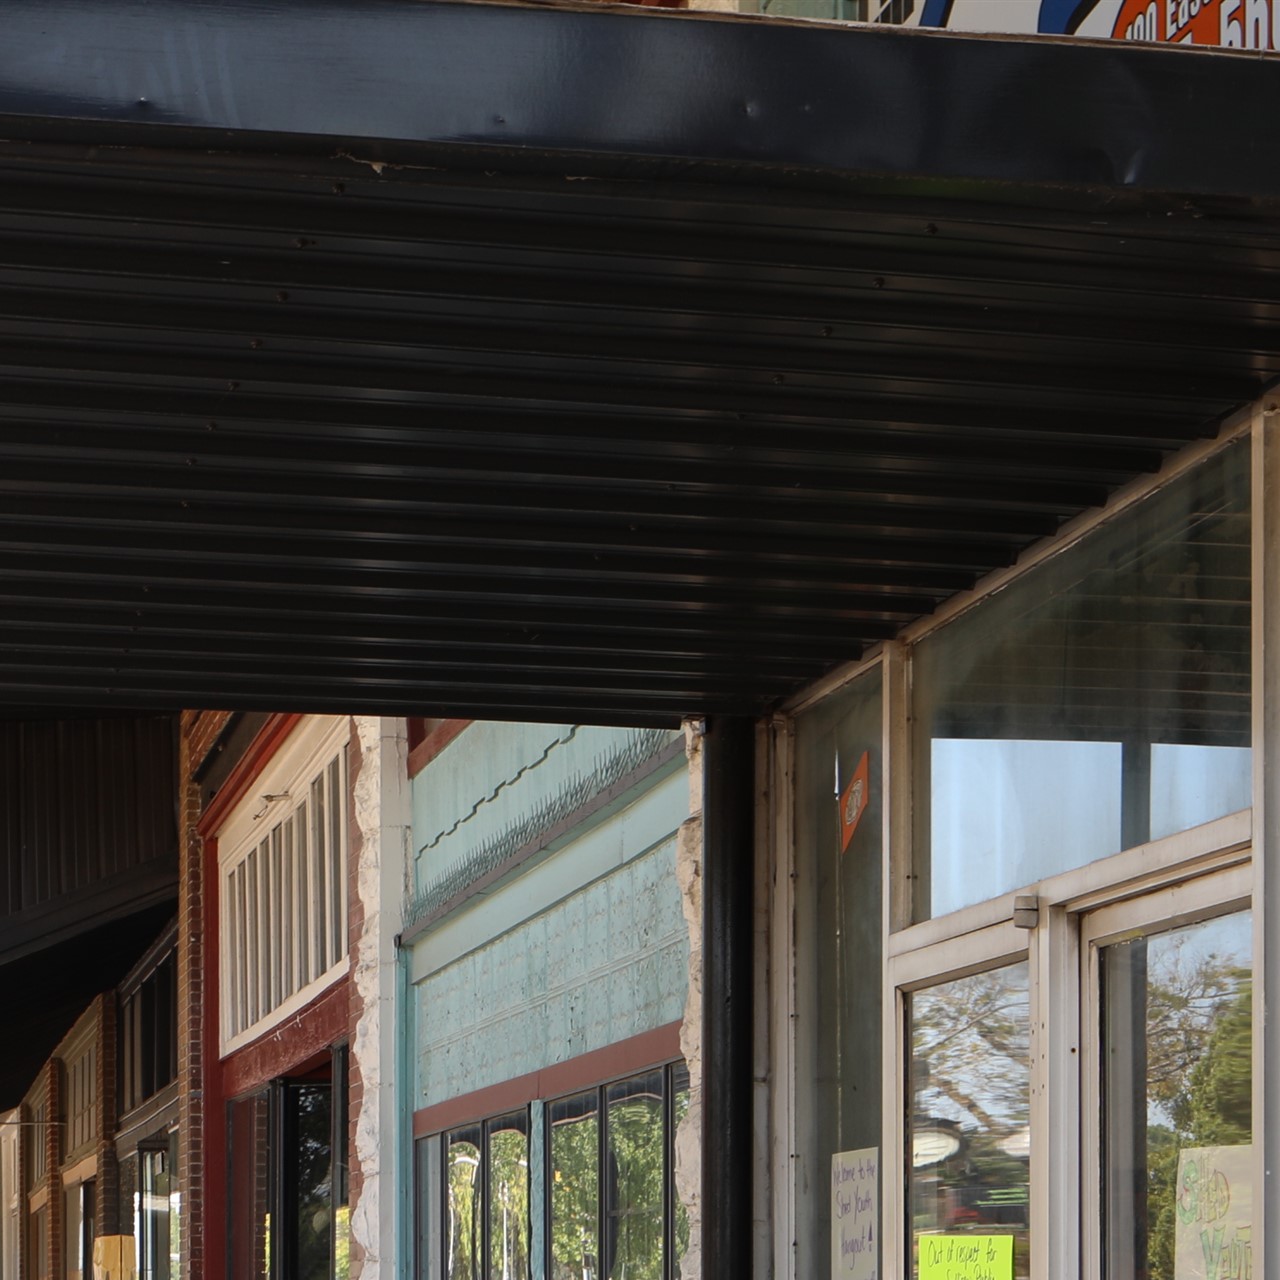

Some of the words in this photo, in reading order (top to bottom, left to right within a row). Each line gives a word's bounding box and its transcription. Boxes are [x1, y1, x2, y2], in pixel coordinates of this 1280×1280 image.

[928, 1240, 942, 1267] Out
[947, 1239, 954, 1262] of
[956, 1240, 980, 1270] respect
[986, 1237, 997, 1263] for
